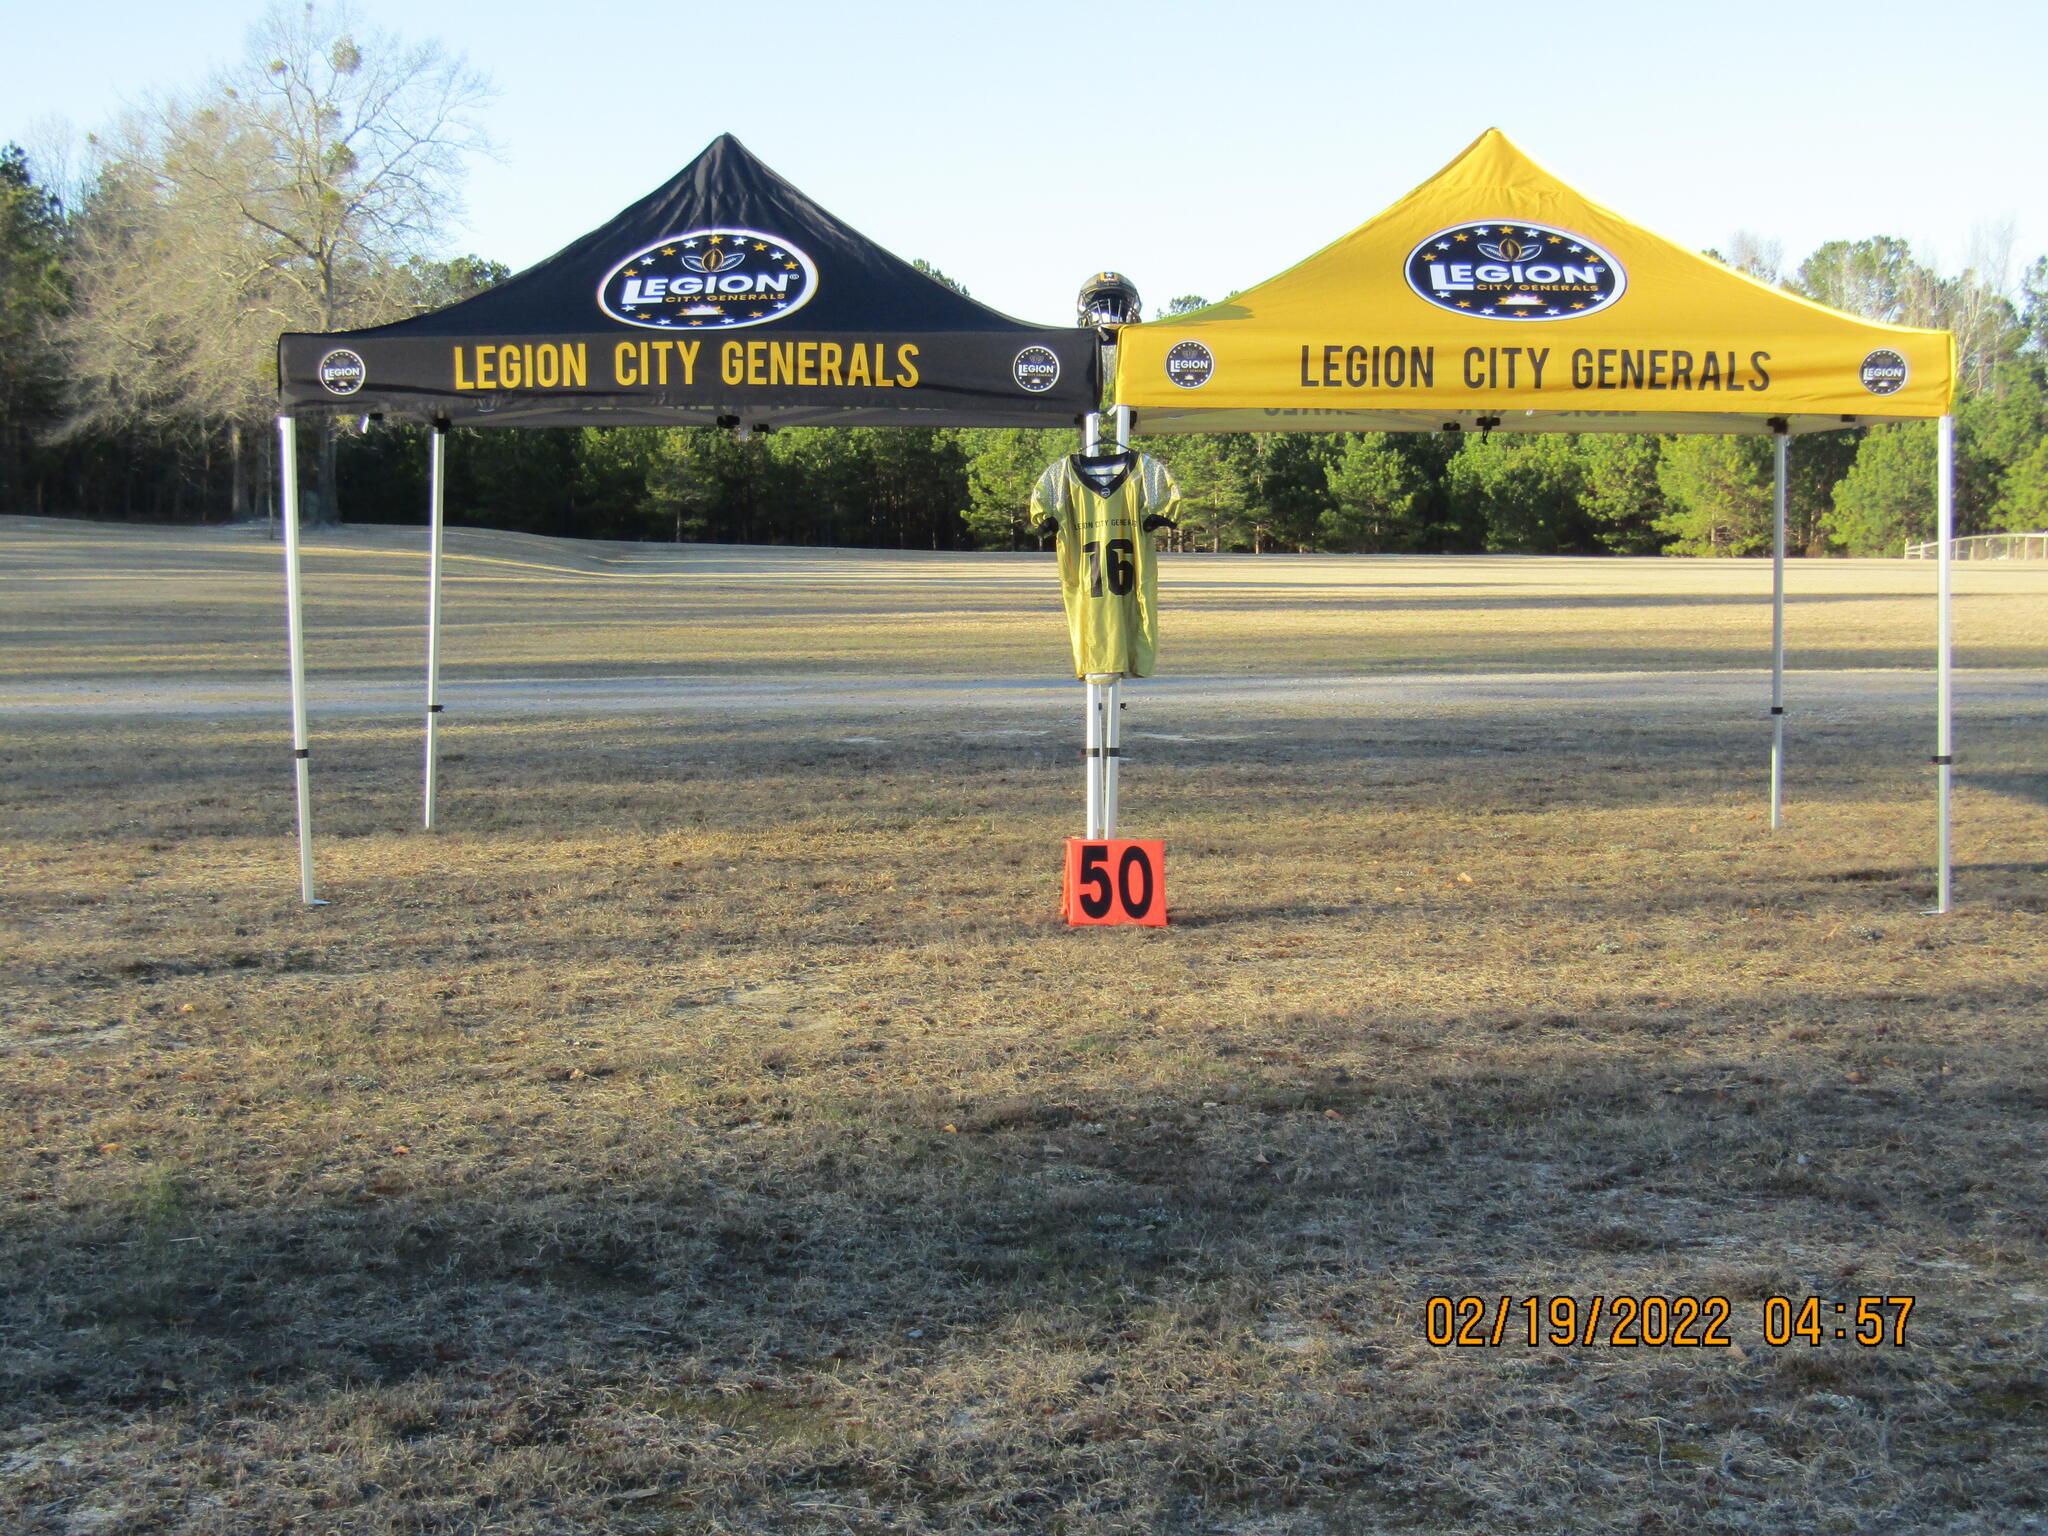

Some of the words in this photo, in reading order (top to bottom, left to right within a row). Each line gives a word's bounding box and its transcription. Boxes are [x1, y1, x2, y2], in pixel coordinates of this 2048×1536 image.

[1429, 264, 1598, 291] LEGION
[621, 273, 789, 304] LEGION
[1519, 284, 1599, 292] GENERALS
[665, 295, 702, 303] CITY
[707, 293, 786, 302] GENERALS
[454, 343, 587, 390] LEGION
[614, 341, 701, 386] CITY
[721, 341, 920, 388] GENERALS
[1018, 364, 1054, 376] LEGION
[1170, 359, 1208, 372] LEGION
[1300, 345, 1434, 388] LEGION
[1463, 347, 1551, 389] CITY
[1571, 348, 1771, 392] GENERALS
[324, 367, 360, 380] LEGION
[1863, 367, 1903, 380] LEGION
[1080, 845, 1153, 919] 50
